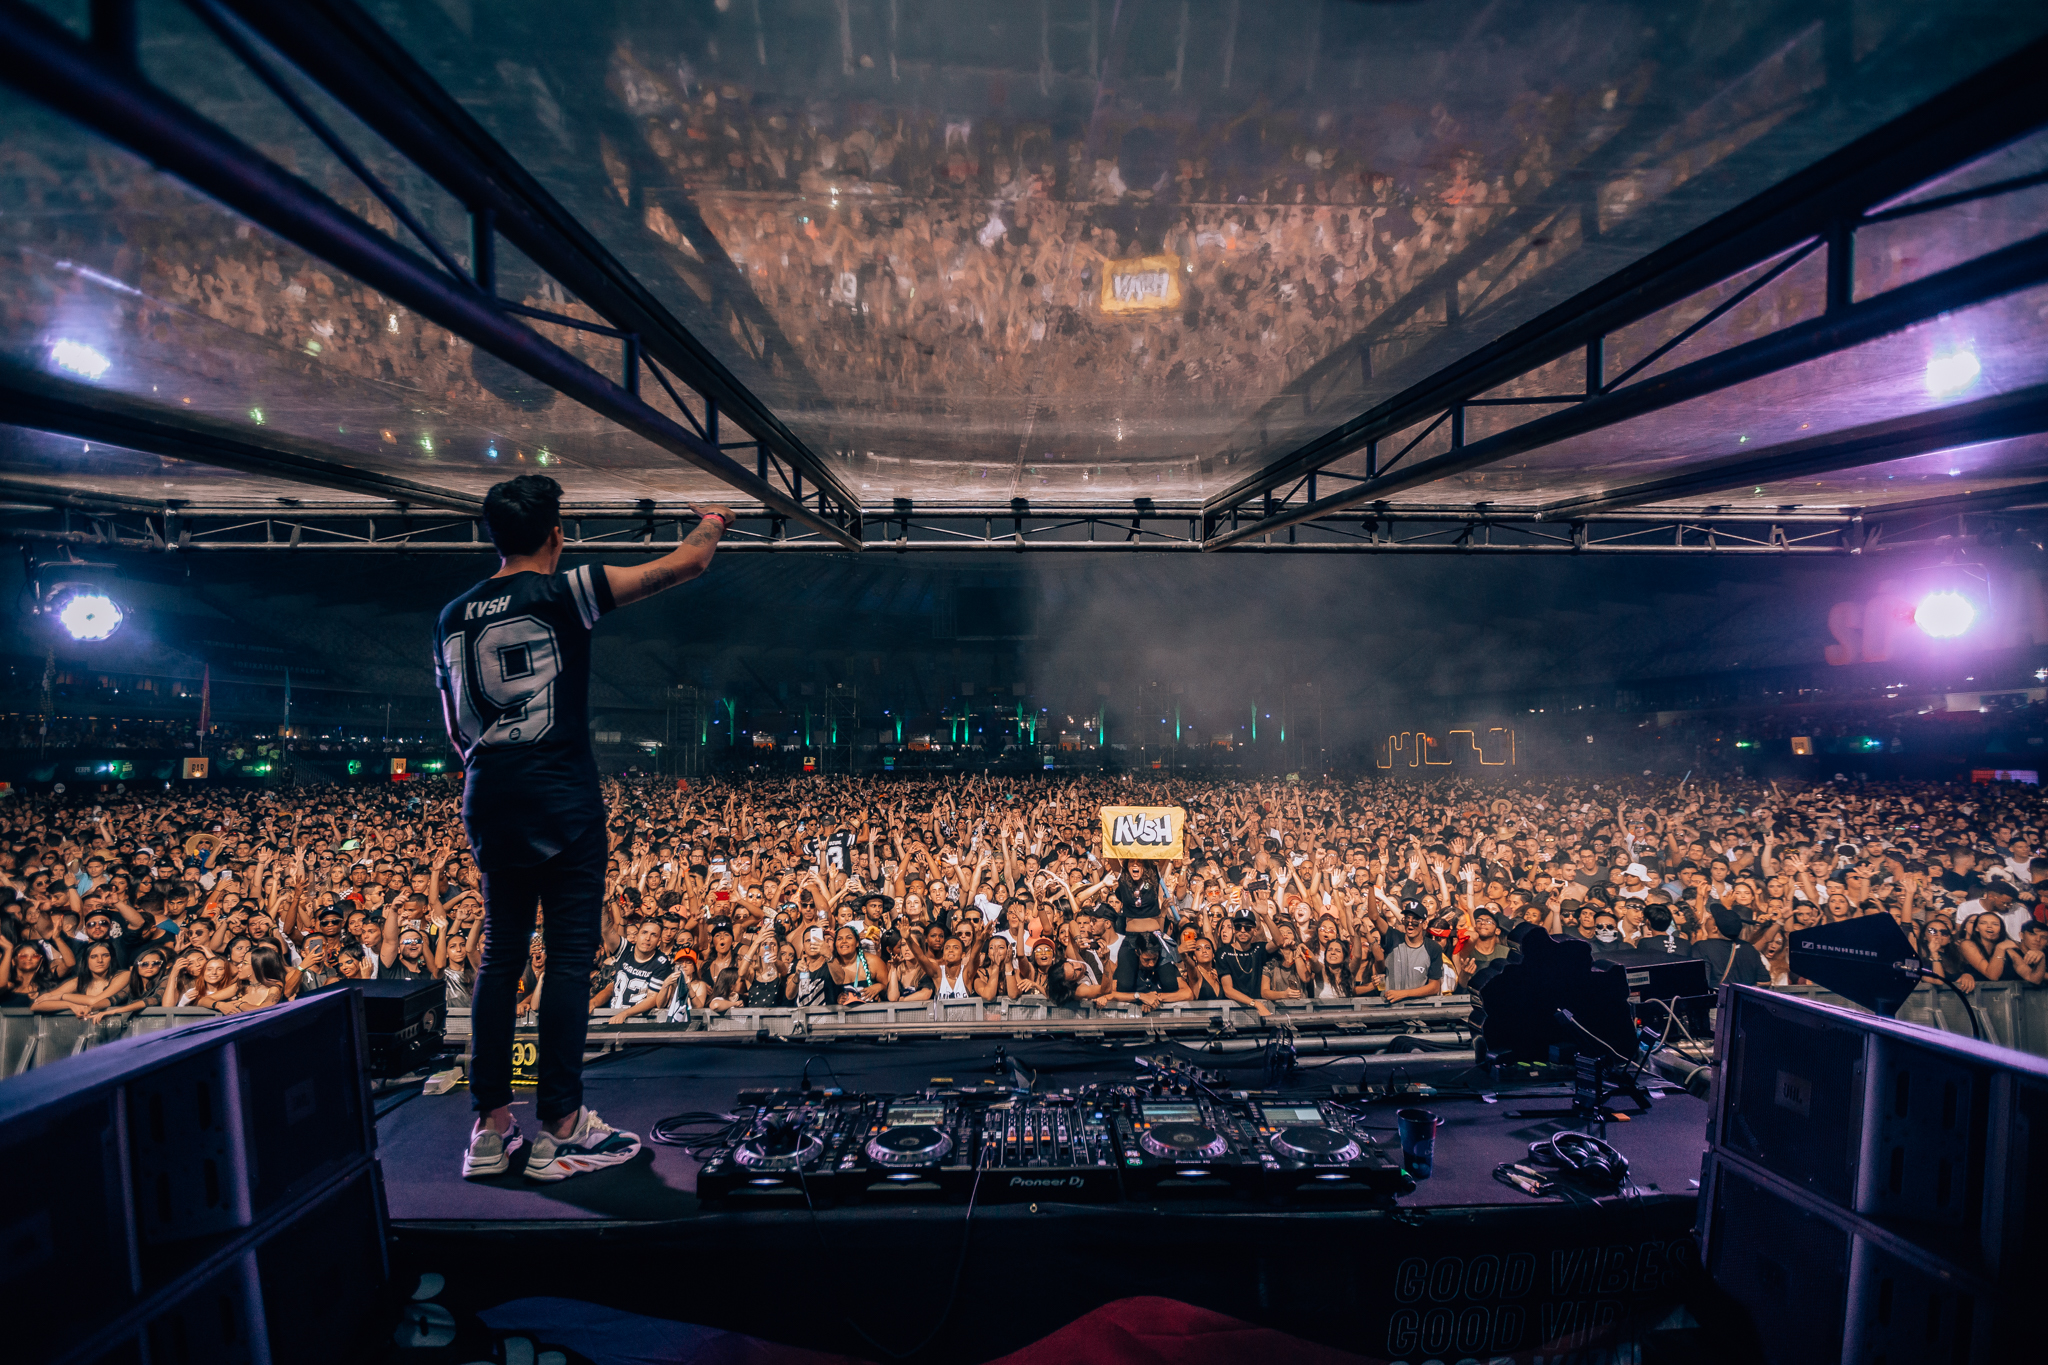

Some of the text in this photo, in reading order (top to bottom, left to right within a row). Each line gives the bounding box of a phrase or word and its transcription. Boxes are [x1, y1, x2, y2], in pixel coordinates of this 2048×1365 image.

[464, 595, 512, 621] KVSH
[442, 614, 563, 749] 19
[191, 763, 205, 773] BAR
[1111, 812, 1173, 846] KVSH
[1816, 943, 1878, 957] SENNHEISER
[1009, 1176, 1066, 1187] Pioneer
[1393, 1252, 1536, 1304] GOOD
[1550, 1237, 1695, 1297] VIBES
[1386, 1304, 1527, 1357] GOOD
